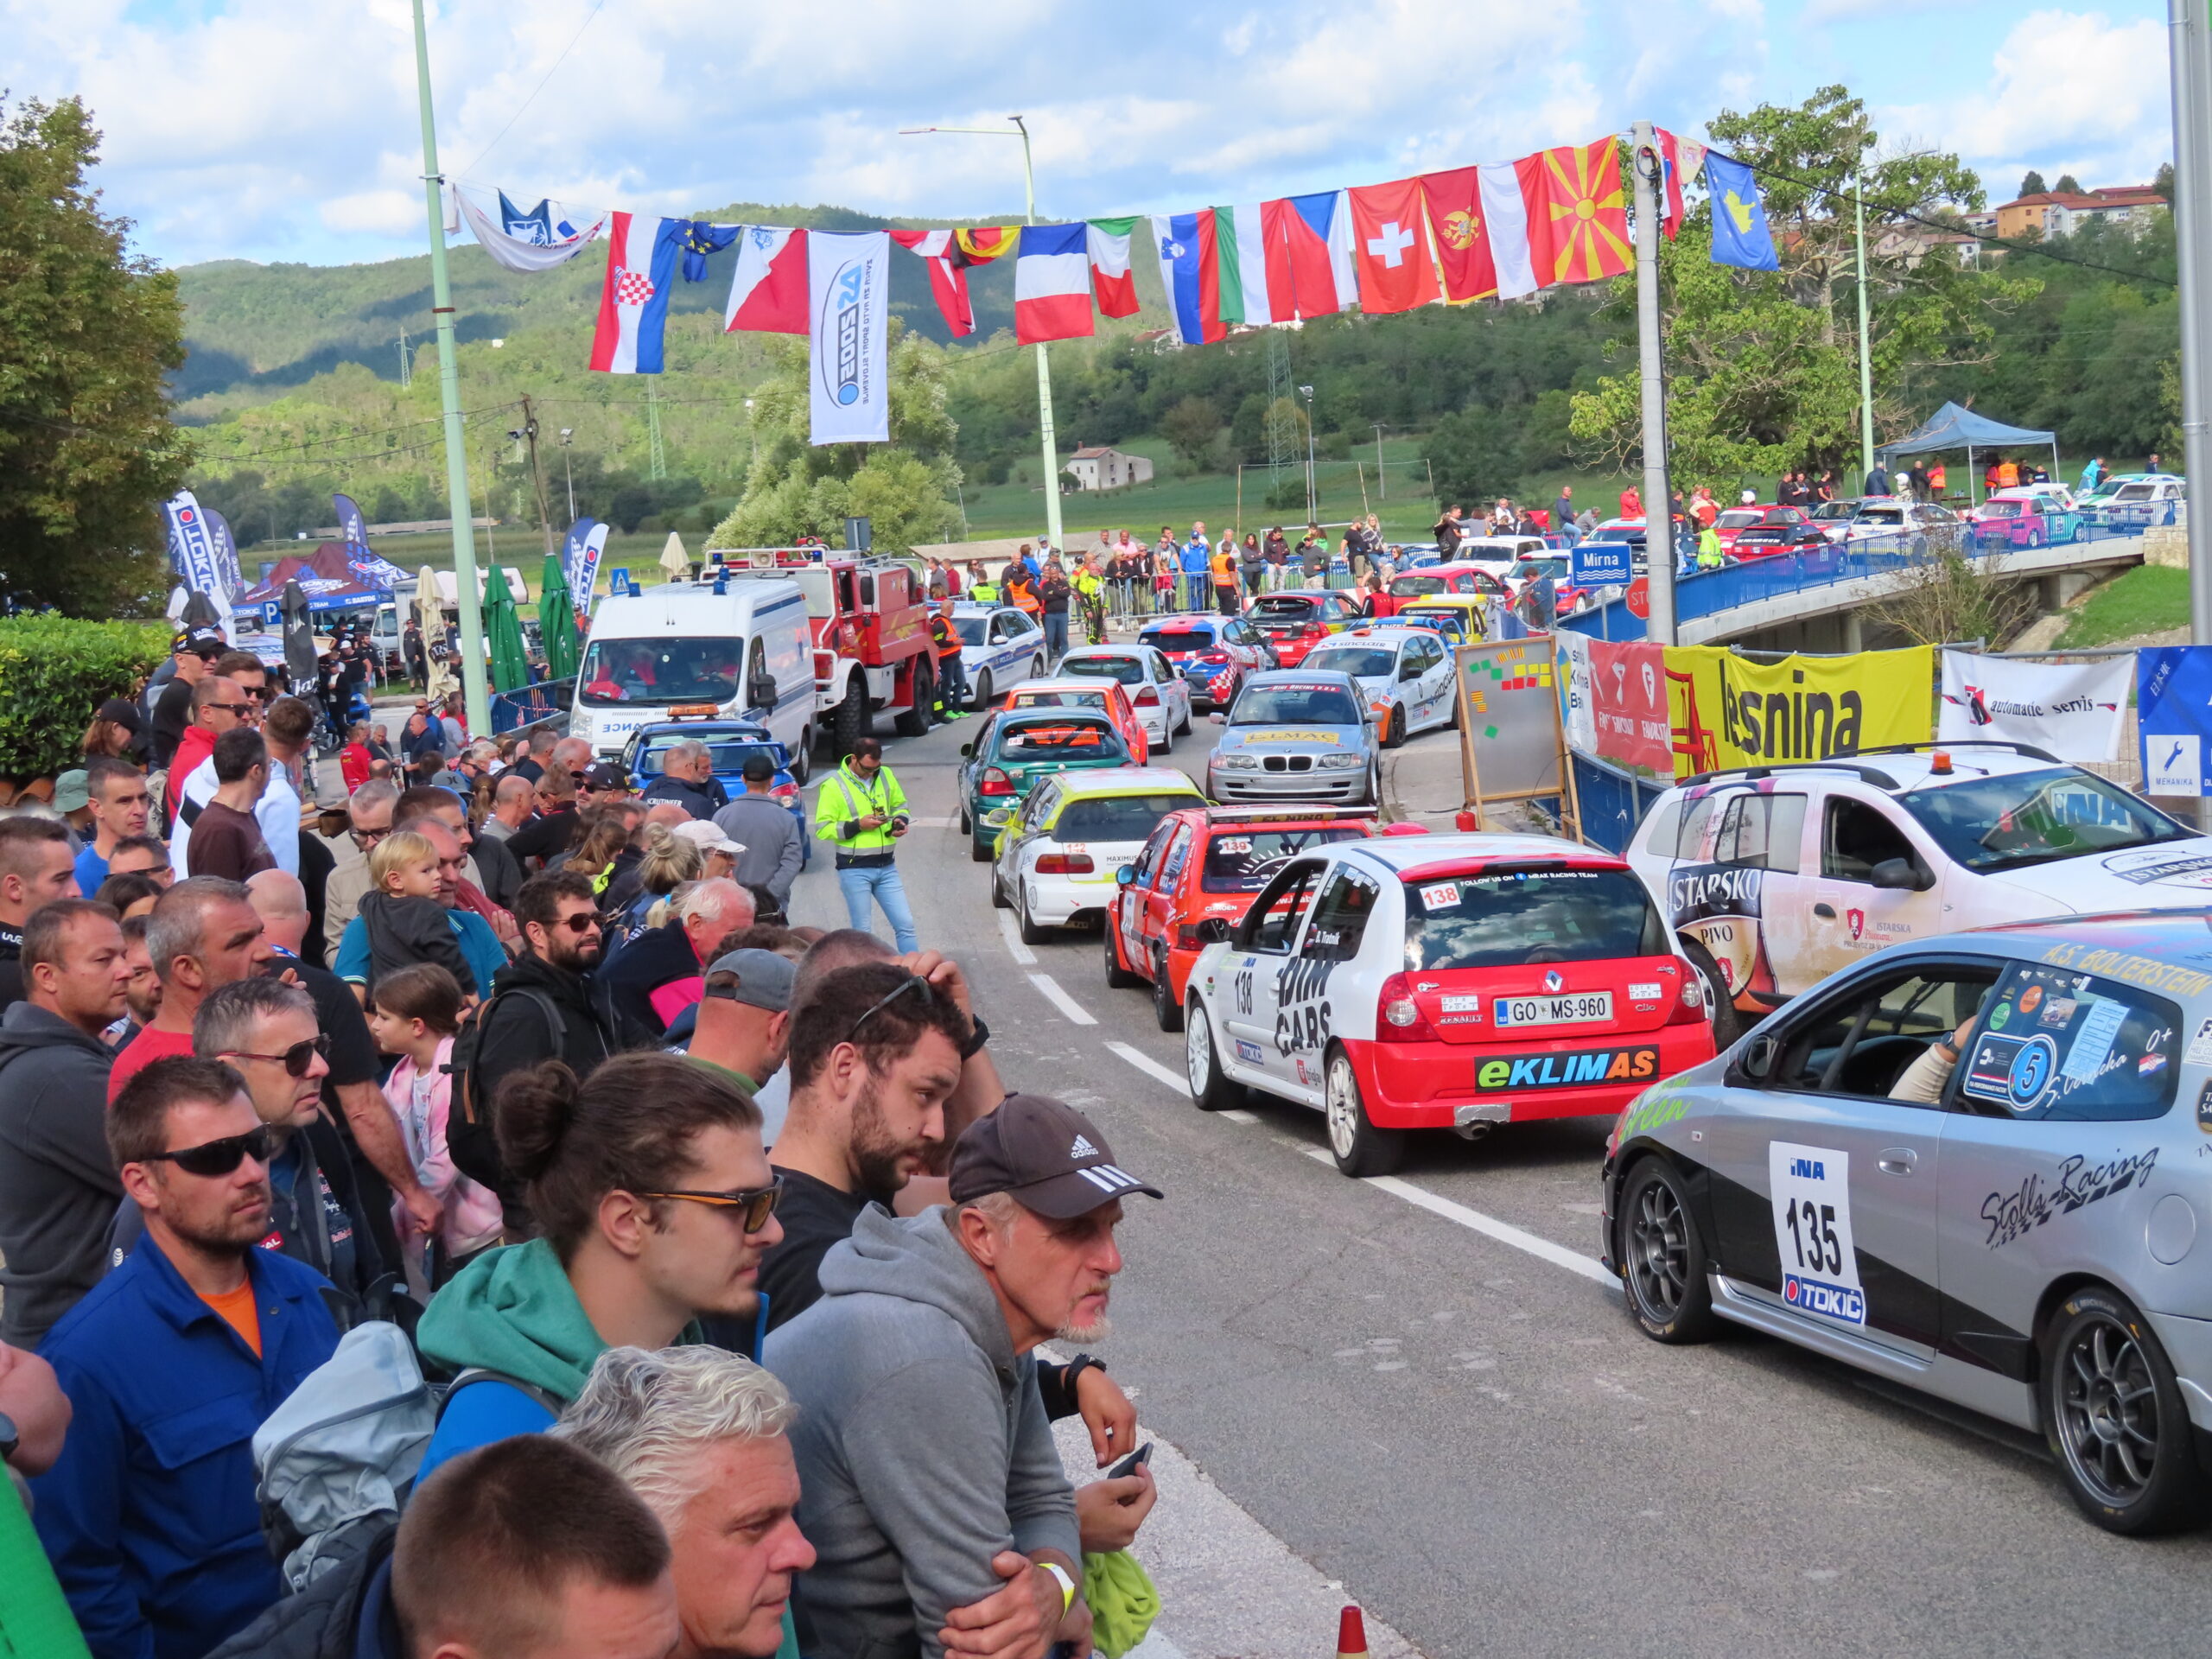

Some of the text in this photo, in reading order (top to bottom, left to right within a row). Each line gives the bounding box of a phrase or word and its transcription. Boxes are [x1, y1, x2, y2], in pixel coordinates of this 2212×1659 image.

[1584, 553, 1618, 567] Mirna
[1631, 591, 1649, 607] ST
[265, 602, 277, 623] P
[1719, 658, 1862, 759] lesnina
[1990, 695, 2094, 717] automatic servis
[2155, 778, 2194, 786] MEHANIKA
[1067, 843, 1086, 853] 142
[1223, 841, 1248, 851] 139
[1459, 876, 1491, 887] FOLLOW
[1669, 868, 1763, 912] ISTARSKO
[1423, 887, 1459, 906] 138
[1700, 925, 1733, 945] PIVO
[1876, 921, 1911, 933] ISTARSKA
[1235, 969, 1253, 1016] 138
[1512, 997, 1606, 1021] GO MS-960
[1635, 1003, 1656, 1012] Clio
[1274, 1001, 1332, 1058] CARS
[1440, 1014, 1484, 1025] RENAULT
[1478, 1049, 1657, 1088] eKLIMAS
[2021, 1052, 2043, 1091] 5
[1071, 1147, 1098, 1159] adidas
[1790, 1157, 1825, 1180] INA
[2058, 1147, 2160, 1204] Racing
[1787, 1198, 1841, 1276] 135
